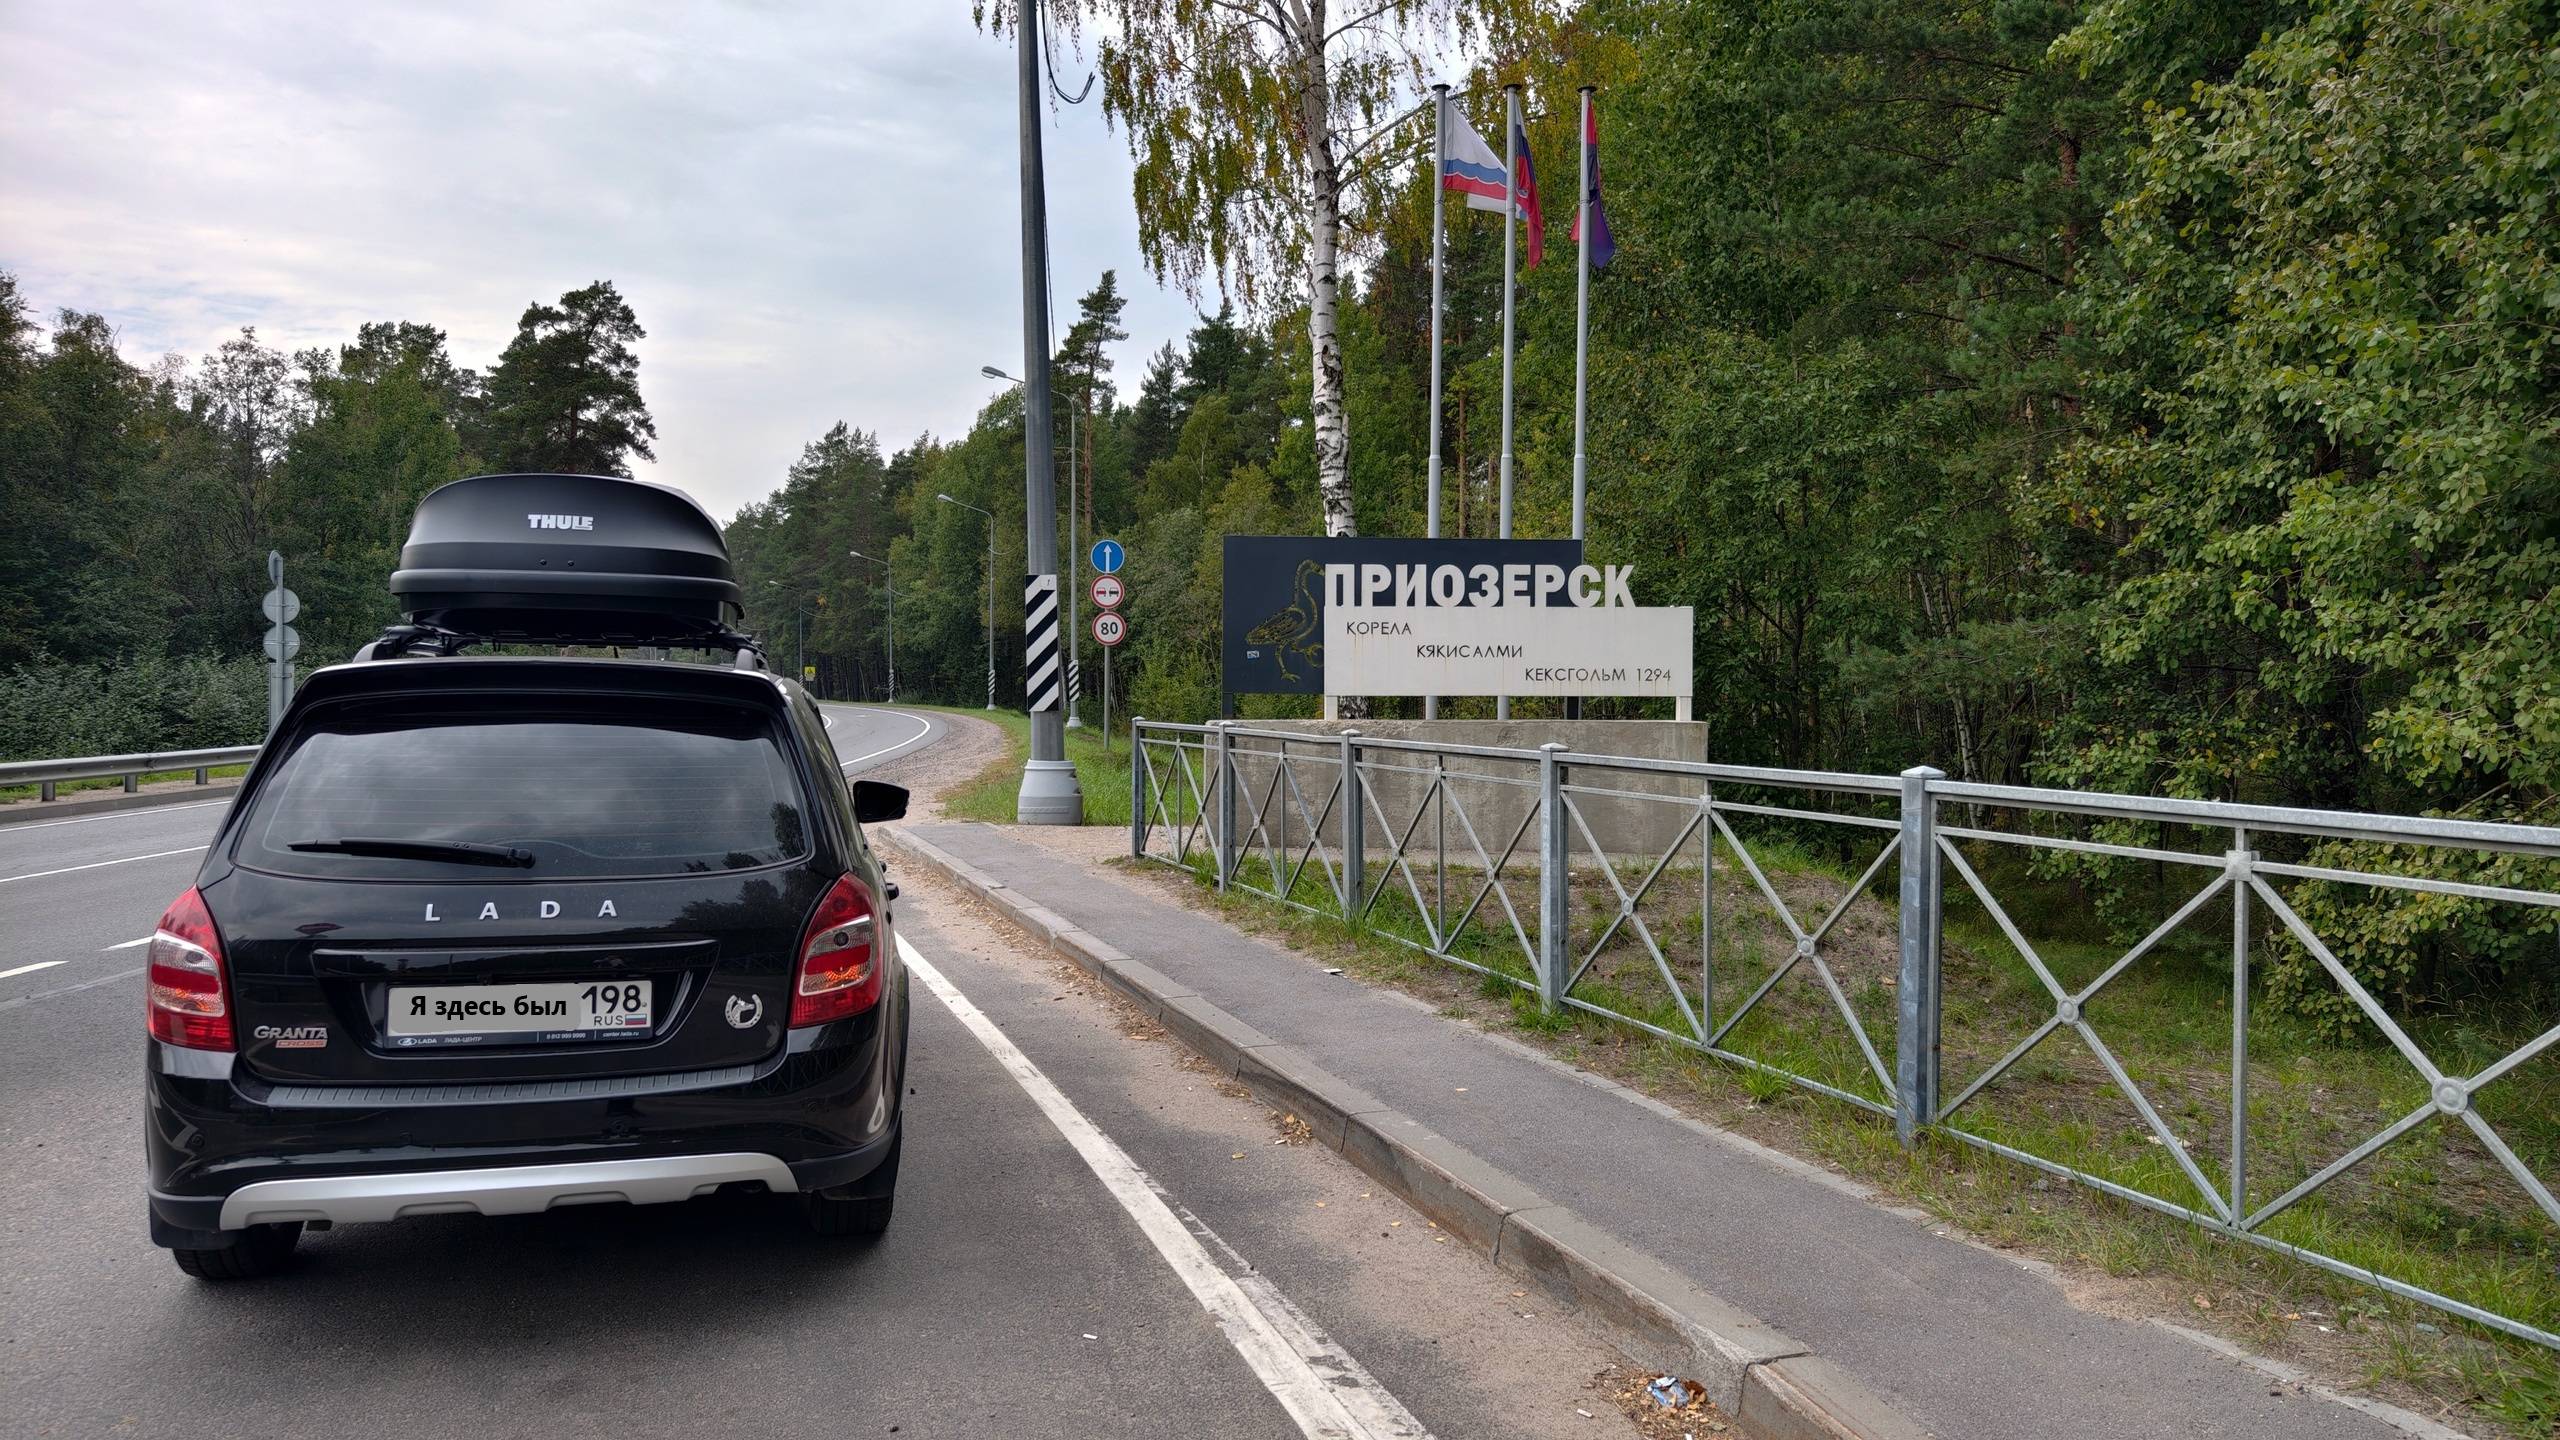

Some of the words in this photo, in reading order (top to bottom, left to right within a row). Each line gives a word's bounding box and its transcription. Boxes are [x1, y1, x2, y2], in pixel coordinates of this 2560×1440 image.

[528, 514, 594, 530] THULE
[1325, 563, 1636, 608] ПРИОЗЕРСК
[1101, 622, 1118, 635] 80
[1346, 621, 1412, 636] КОРЕЛА
[1416, 645, 1523, 658] КЯКИСАЛМИ
[1525, 668, 1626, 682] КЕКСГОЛЬМ
[1636, 668, 1671, 682] 1294
[425, 899, 618, 921] LADA
[581, 985, 642, 1015] 198
[594, 1015, 624, 1026] RUS
[254, 1025, 328, 1039] GRANTA
